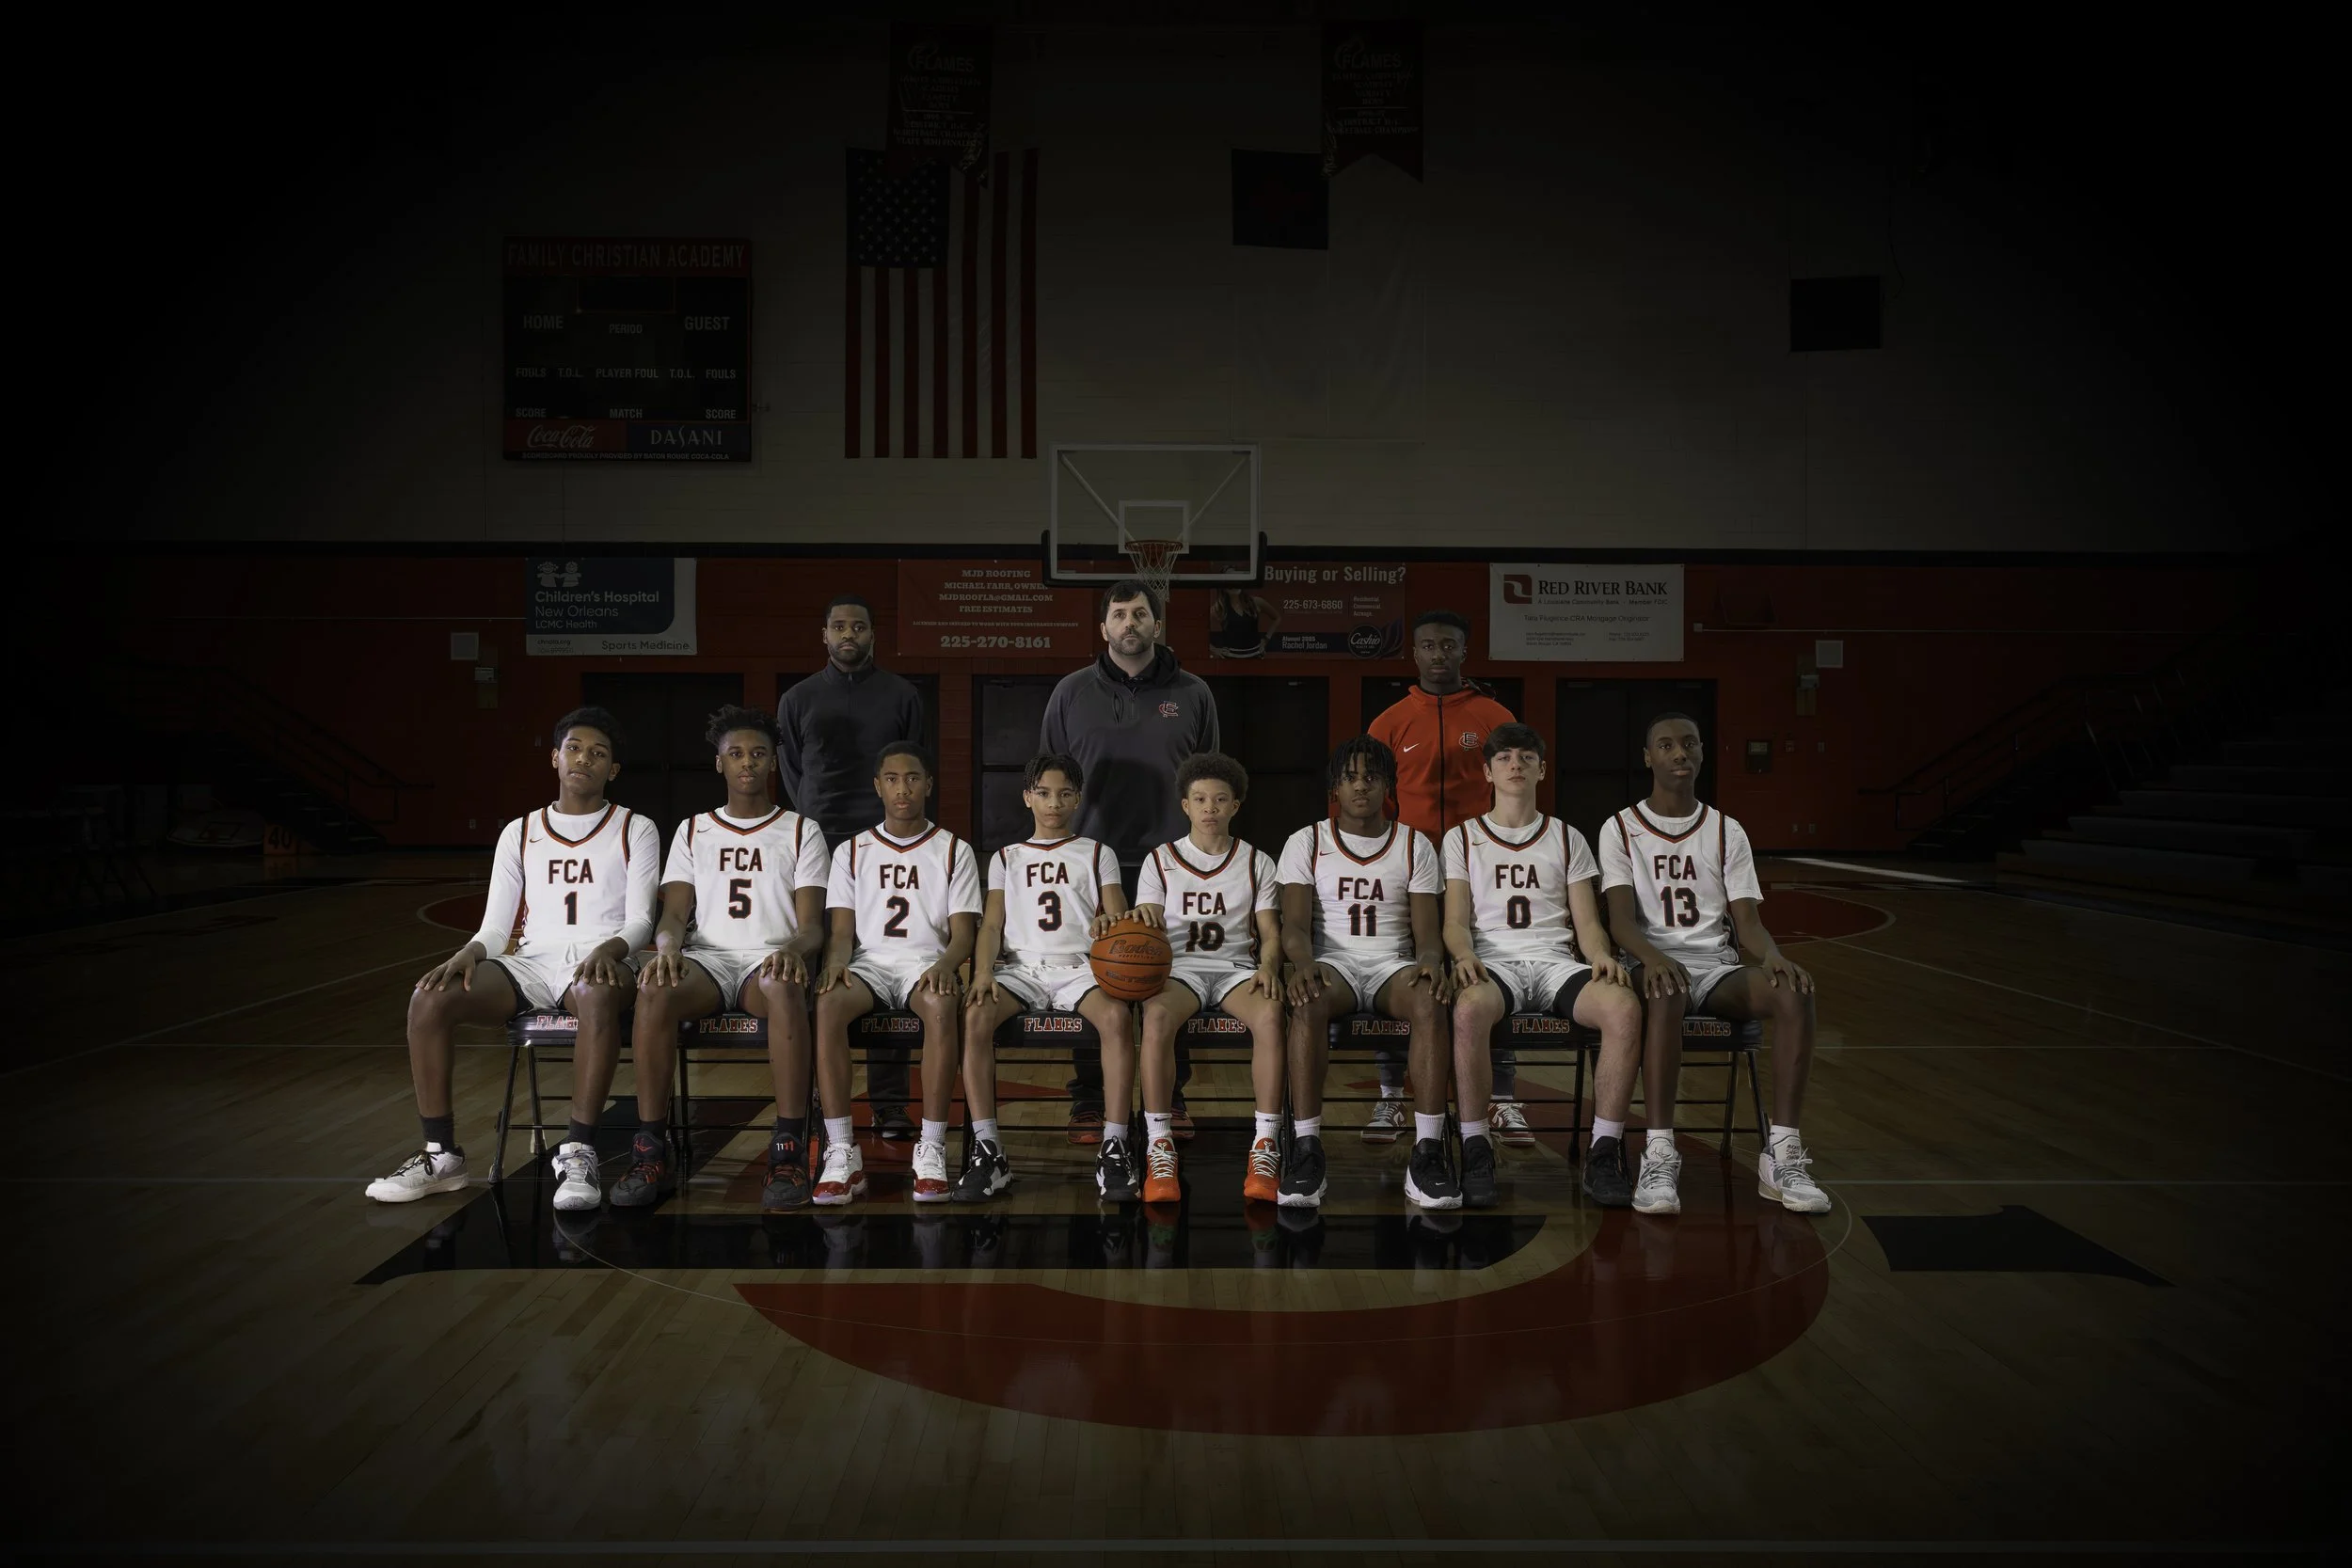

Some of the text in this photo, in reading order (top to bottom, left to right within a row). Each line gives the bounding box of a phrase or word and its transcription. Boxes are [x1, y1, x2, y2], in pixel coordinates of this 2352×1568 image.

[508, 244, 744, 267] FAMILY CHRISTIAN ACADEMY
[523, 314, 564, 329] HOME
[609, 324, 643, 334] PERIOD
[684, 316, 730, 331] GUEST
[516, 368, 547, 378] FOULS
[596, 368, 659, 378] PLAYER FOUL
[706, 369, 737, 379] FOULS
[516, 407, 547, 419] SCORE
[610, 408, 643, 420] MATCH
[706, 409, 737, 420] SCORE
[650, 425, 722, 449] DASANI
[961, 570, 1031, 578] MJD ROOFING
[1264, 565, 1406, 584] Buying or Selling?
[945, 581, 985, 590] MICHAEL
[1538, 580, 1668, 595] RED RIVER BANK
[534, 591, 660, 606] Children's Hospital
[1283, 599, 1343, 610] 225-673-6860
[534, 605, 619, 617] New Orleans
[959, 605, 1033, 613] FREE ESTIMATES
[535, 620, 597, 629] LCMC Health
[602, 641, 690, 652] Sports Medicine
[940, 636, 1051, 649] 225-270-8161
[1350, 633, 1380, 645] Cashio
[267, 827, 292, 849] 40
[720, 847, 764, 872] FCA
[548, 859, 595, 883] FCA
[1026, 861, 1070, 888] FCA
[1654, 855, 1697, 880] FCA
[880, 863, 919, 890] FCA
[1495, 863, 1541, 890] FCA
[1338, 877, 1384, 902] FCA
[728, 878, 752, 920] 5
[1183, 892, 1227, 916] FCA
[1661, 886, 1700, 927] 13
[564, 892, 577, 926] 1
[1038, 890, 1062, 932] 3
[1506, 895, 1532, 929] 0
[883, 895, 910, 939] 2
[1347, 903, 1377, 937] 11
[1185, 921, 1225, 952] 10
[536, 1016, 579, 1031] FLAM
[700, 1019, 758, 1033] FLAMES
[861, 1018, 920, 1033] FLAMES
[1024, 1018, 1083, 1033] FLAMES
[1188, 1018, 1247, 1033] FLAMES
[1352, 1020, 1410, 1035] FLAMES
[1512, 1019, 1570, 1034] FLAMES
[1682, 1021, 1731, 1037] LAMES
